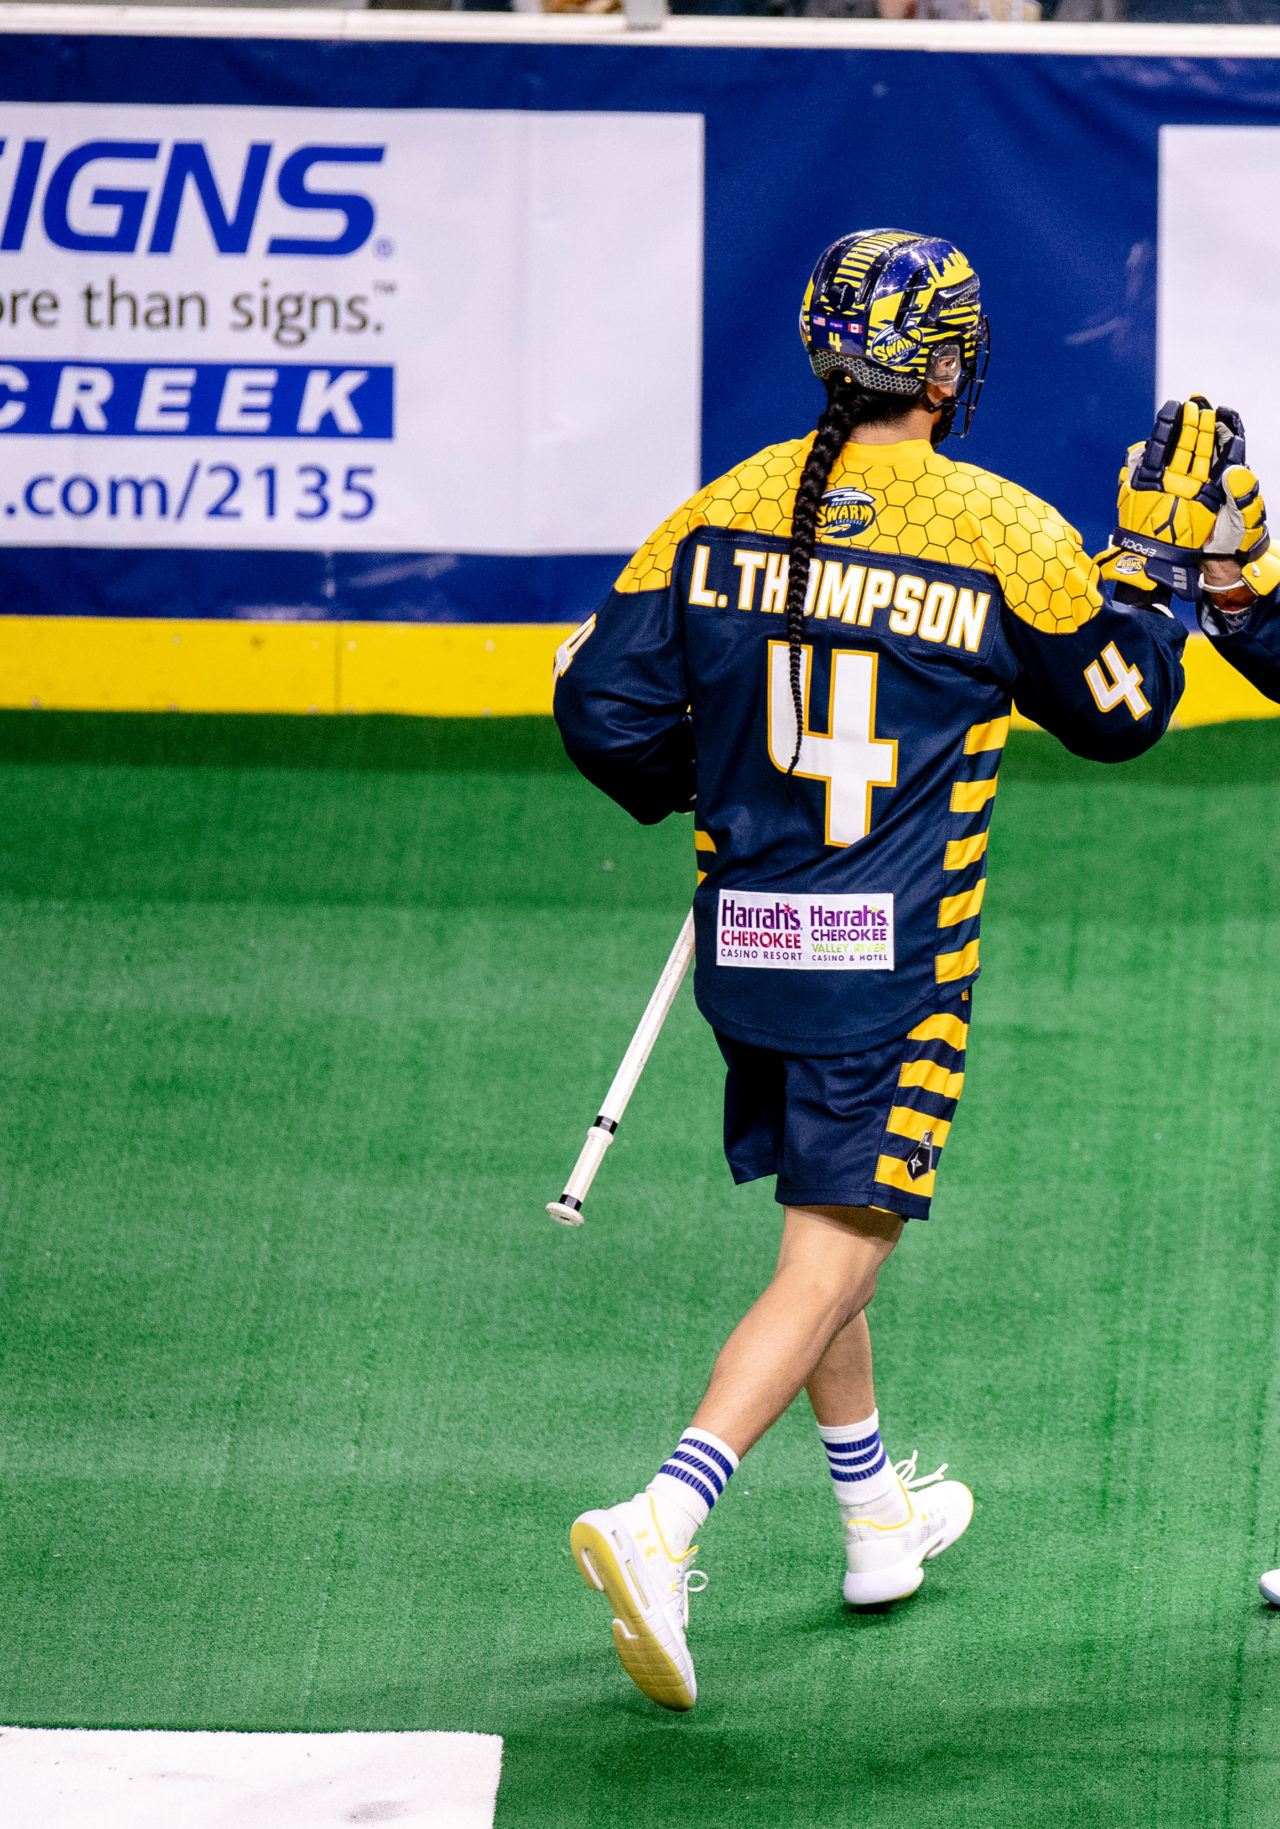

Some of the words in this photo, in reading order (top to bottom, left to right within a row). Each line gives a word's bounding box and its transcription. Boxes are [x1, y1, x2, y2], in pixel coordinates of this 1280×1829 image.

[0, 139, 386, 256] IGNS
[0, 290, 60, 328] re
[82, 275, 206, 329] than
[828, 332, 843, 353] 4
[5, 459, 376, 523] .com/2135
[816, 504, 874, 528] SWARM
[1084, 640, 1152, 721] 4
[768, 640, 898, 848] 4
[721, 929, 801, 949] CHEROKEE
[811, 928, 887, 941] CHEROKEE
[721, 948, 758, 959] CASINO
[763, 950, 802, 961] RESORT
[811, 943, 849, 953] VALLEY
[854, 943, 886, 953] RIVER
[860, 953, 888, 961] HOTEL
